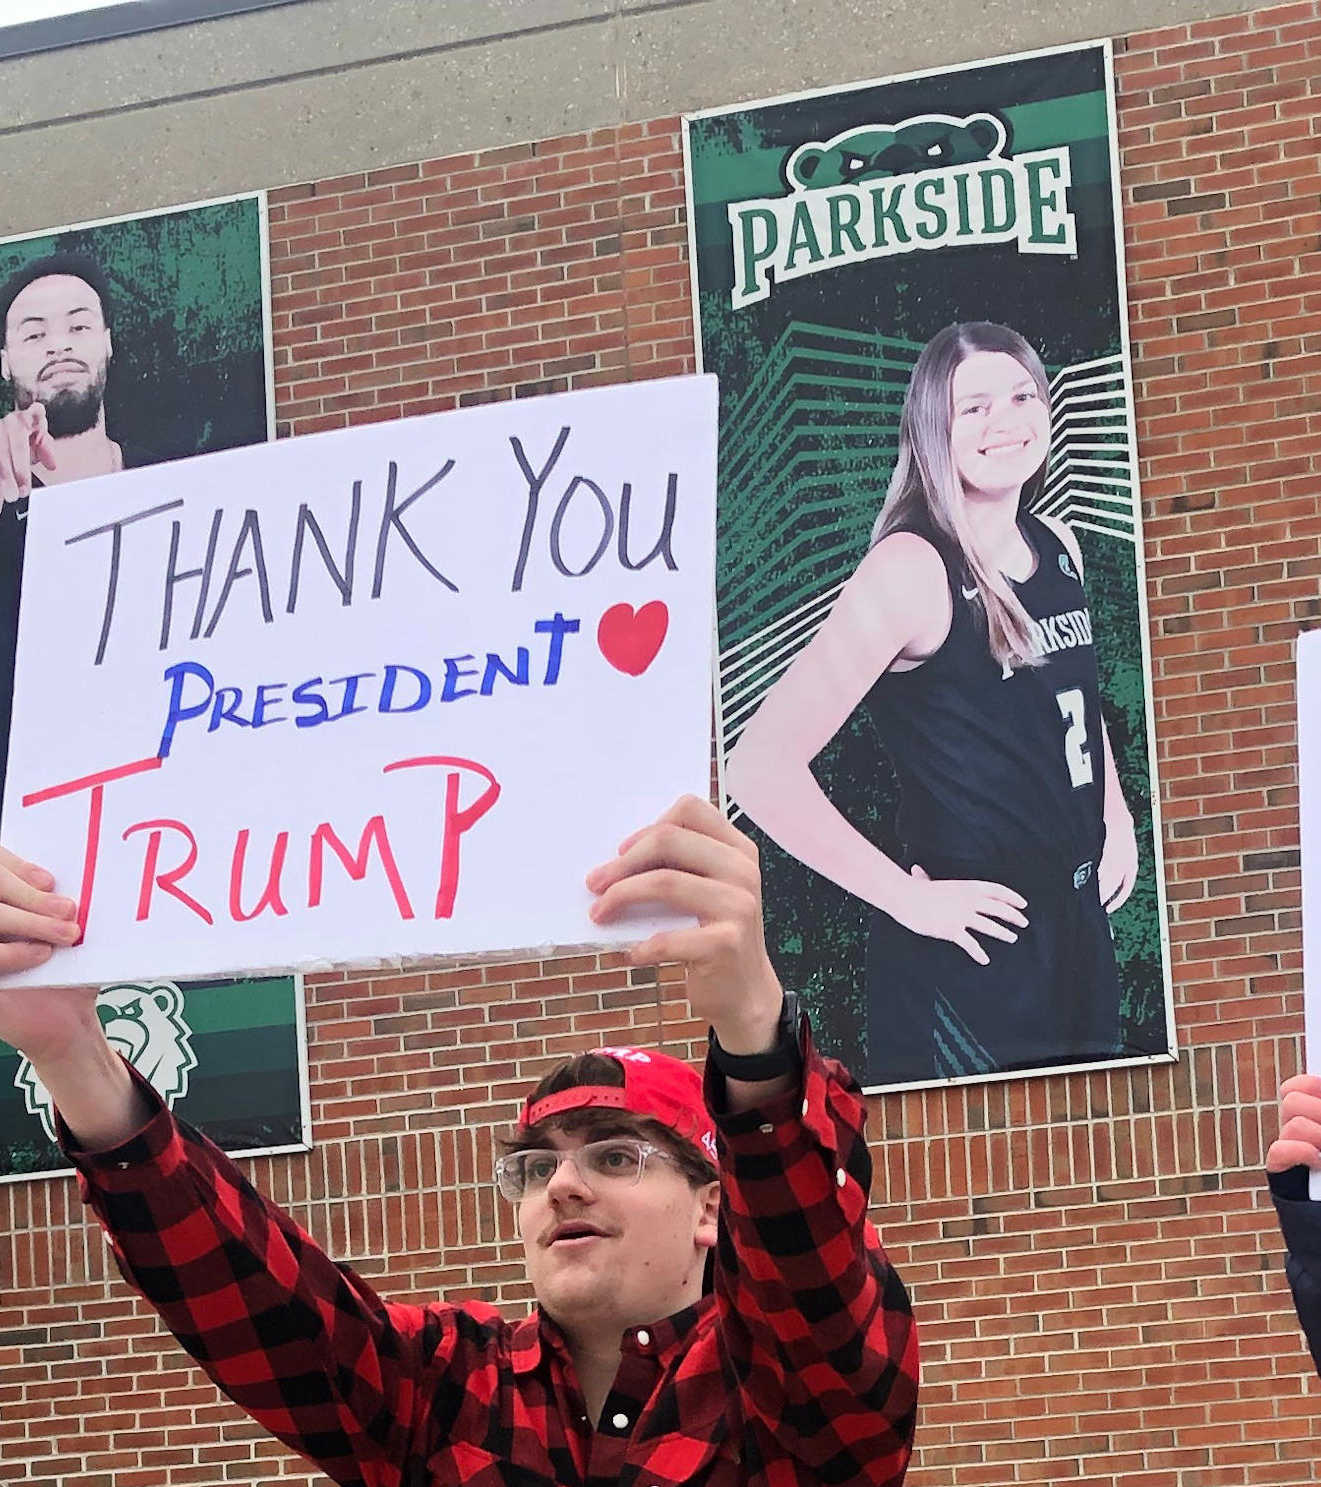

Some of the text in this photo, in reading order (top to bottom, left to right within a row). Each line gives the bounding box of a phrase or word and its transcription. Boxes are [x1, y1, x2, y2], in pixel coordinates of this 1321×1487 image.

[734, 155, 1068, 299] PARKSIDE
[64, 426, 679, 665] THANK YOU
[156, 612, 580, 760] PRESIDENT
[1055, 688, 1094, 788] 2
[22, 755, 502, 947] TRUMP
